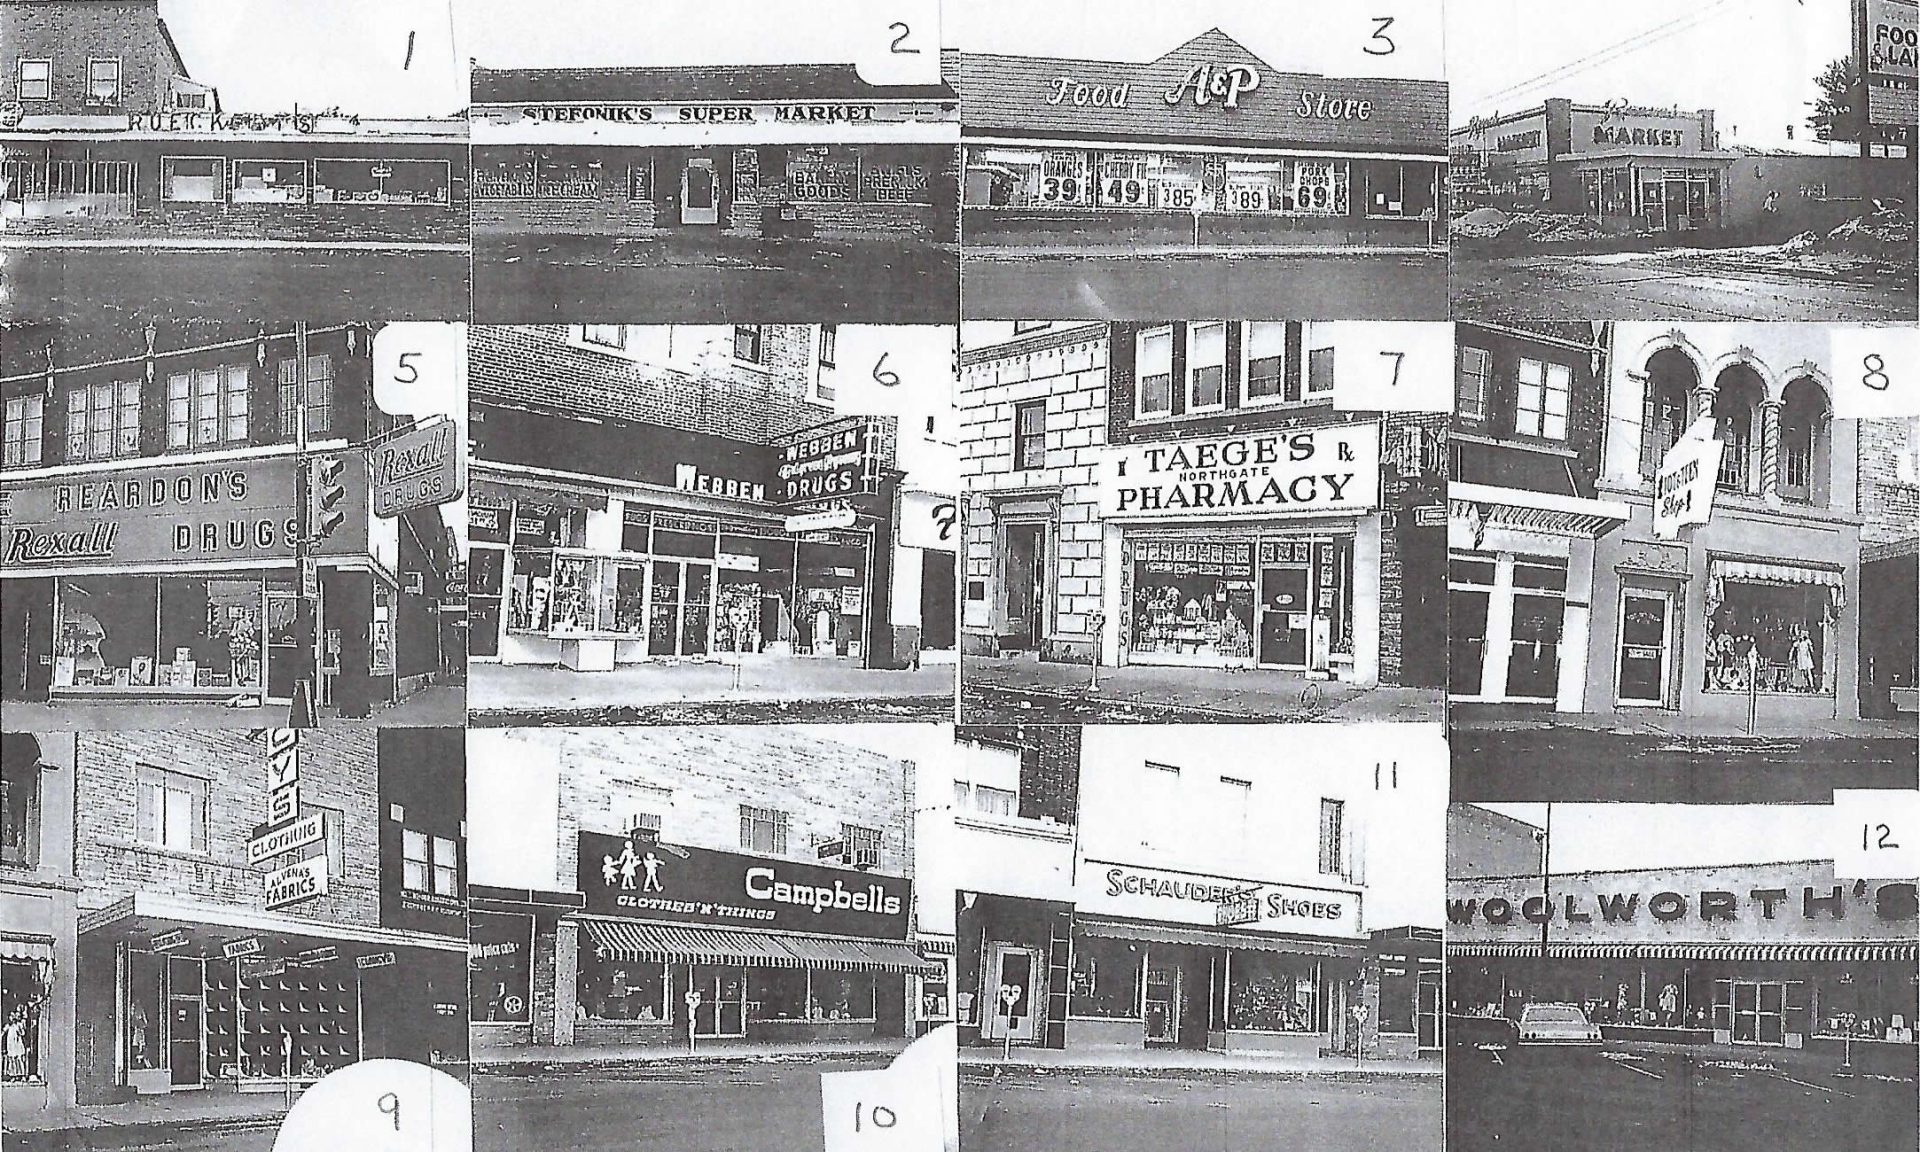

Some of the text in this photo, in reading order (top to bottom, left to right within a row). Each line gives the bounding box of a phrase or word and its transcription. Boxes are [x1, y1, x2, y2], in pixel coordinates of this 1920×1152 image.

[405, 30, 416, 71] 1
[888, 21, 921, 55] 2
[1363, 16, 1396, 56] 3
[1045, 76, 1130, 109] Food
[1163, 62, 1261, 109] A&P
[522, 105, 877, 122] STEFONIK'S SUPER MARKET
[1295, 89, 1374, 121] Store
[1592, 125, 1685, 148] MARKET
[1043, 159, 1084, 179] ORANGES
[1300, 176, 1330, 187] CHOPS
[1301, 167, 1328, 177] PORK
[794, 185, 851, 200] GOODS
[1043, 178, 1077, 201] 39
[1107, 180, 1141, 203] 49
[1297, 186, 1327, 208] 69
[393, 351, 423, 384] 5
[872, 352, 901, 387] 6
[1379, 350, 1406, 387] 7
[1861, 352, 1890, 392] 8
[380, 427, 449, 485] Rexall
[785, 430, 857, 462] WEBBEN
[1144, 432, 1316, 473] TAEGE'S
[674, 462, 766, 502] WEBBEN
[786, 470, 853, 500] DRUGS
[1179, 465, 1270, 483] NORTHGATE
[56, 469, 249, 513] REARDON'S
[382, 475, 444, 509] DRUGS
[1117, 473, 1355, 512] PHARMACY
[3, 521, 119, 563] Rexall
[173, 519, 299, 552] DRUGS
[1374, 761, 1398, 791] 11
[251, 821, 317, 858] CLOTHING
[1861, 823, 1900, 852] 12
[266, 876, 316, 906] FABRICS
[744, 867, 902, 916] Campbells
[1446, 878, 1918, 925] WOOLWORTH'S
[377, 1092, 401, 1132] 9
[854, 1101, 897, 1133] 10
